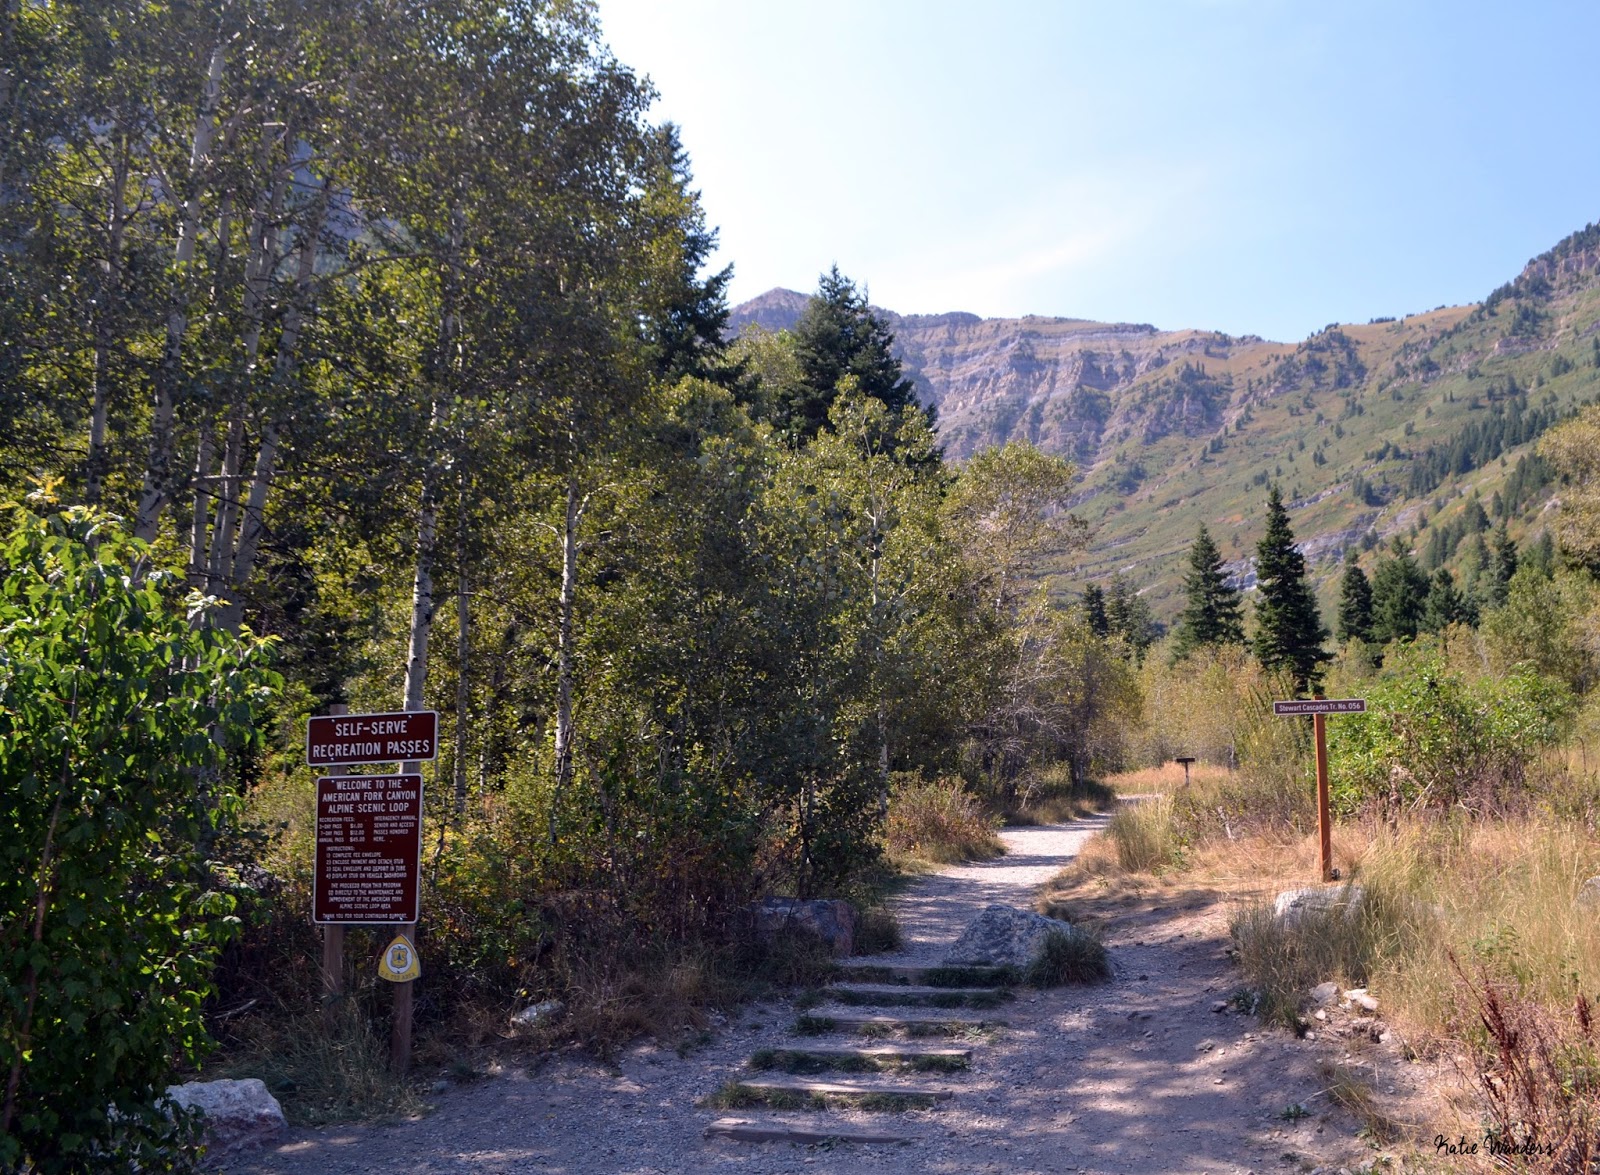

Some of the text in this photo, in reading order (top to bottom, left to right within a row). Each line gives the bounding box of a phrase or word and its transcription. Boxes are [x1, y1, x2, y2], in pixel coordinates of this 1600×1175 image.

[336, 721, 407, 736] SELF-SERVE
[313, 740, 429, 757] RECREATION PASSES
[337, 780, 402, 790] WELCOME TO THE
[322, 791, 416, 802] AMERICAN FORK CANYON
[328, 803, 409, 813] ALPINE SCENIC LOOP
